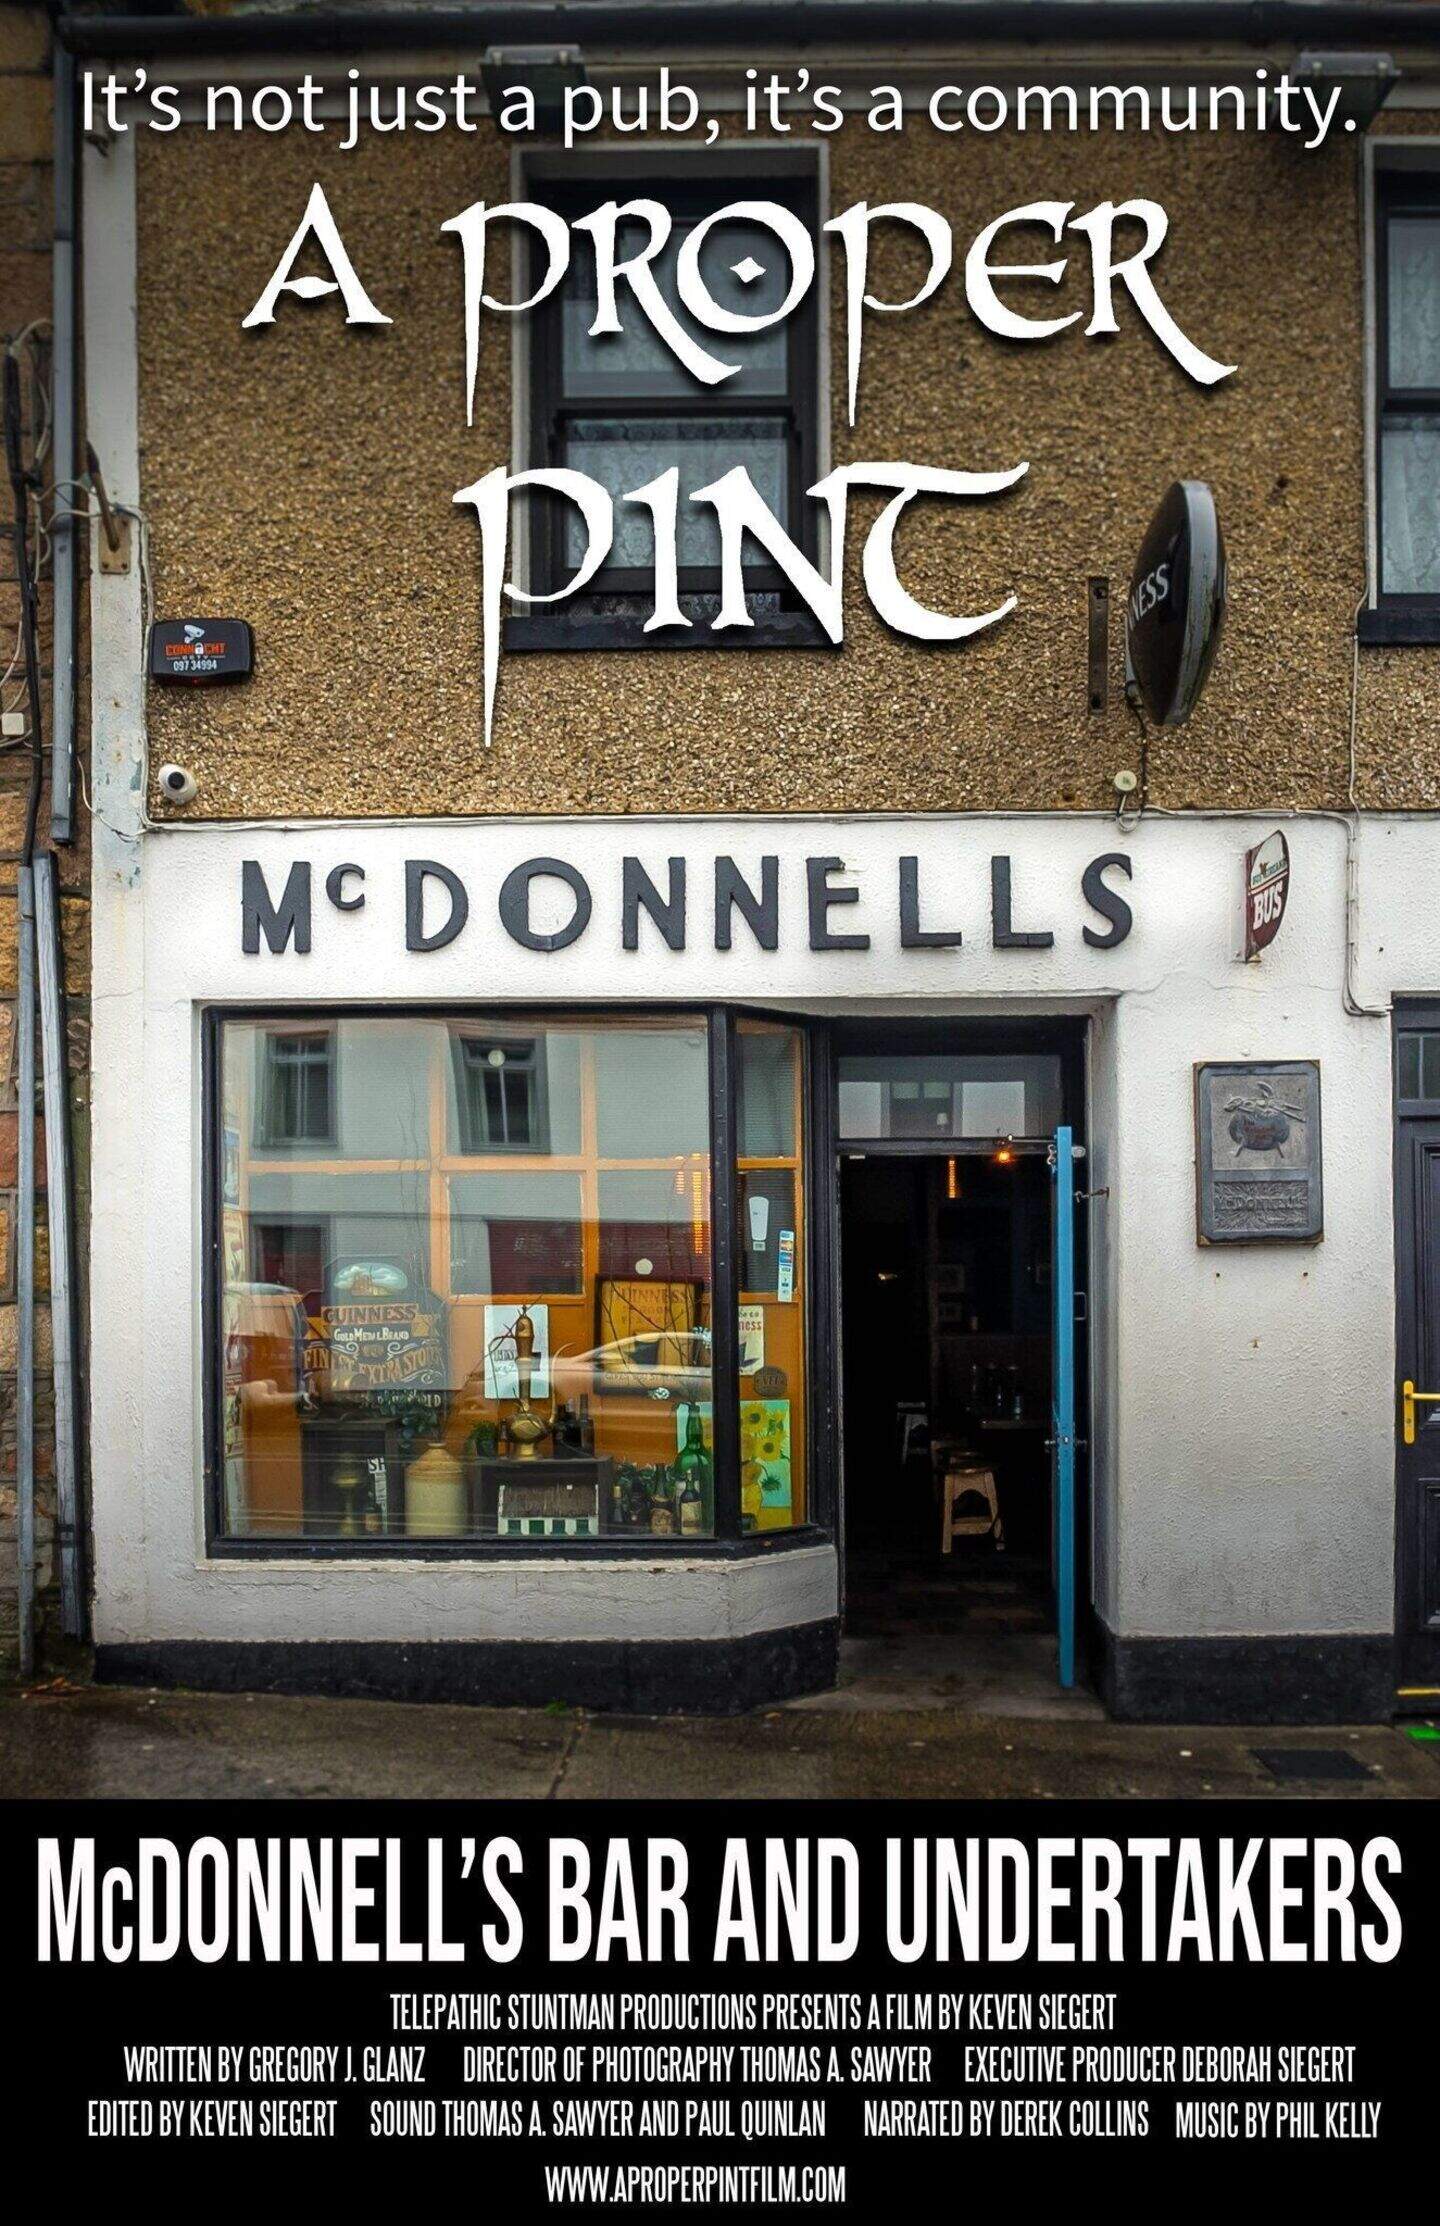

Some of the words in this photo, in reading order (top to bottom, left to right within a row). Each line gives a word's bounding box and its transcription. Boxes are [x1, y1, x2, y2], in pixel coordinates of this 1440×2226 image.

[173, 661, 189, 672] 097
[191, 660, 218, 671] 34994
[1253, 880, 1283, 930] BUS
[323, 1304, 416, 1323] GUINNESS
